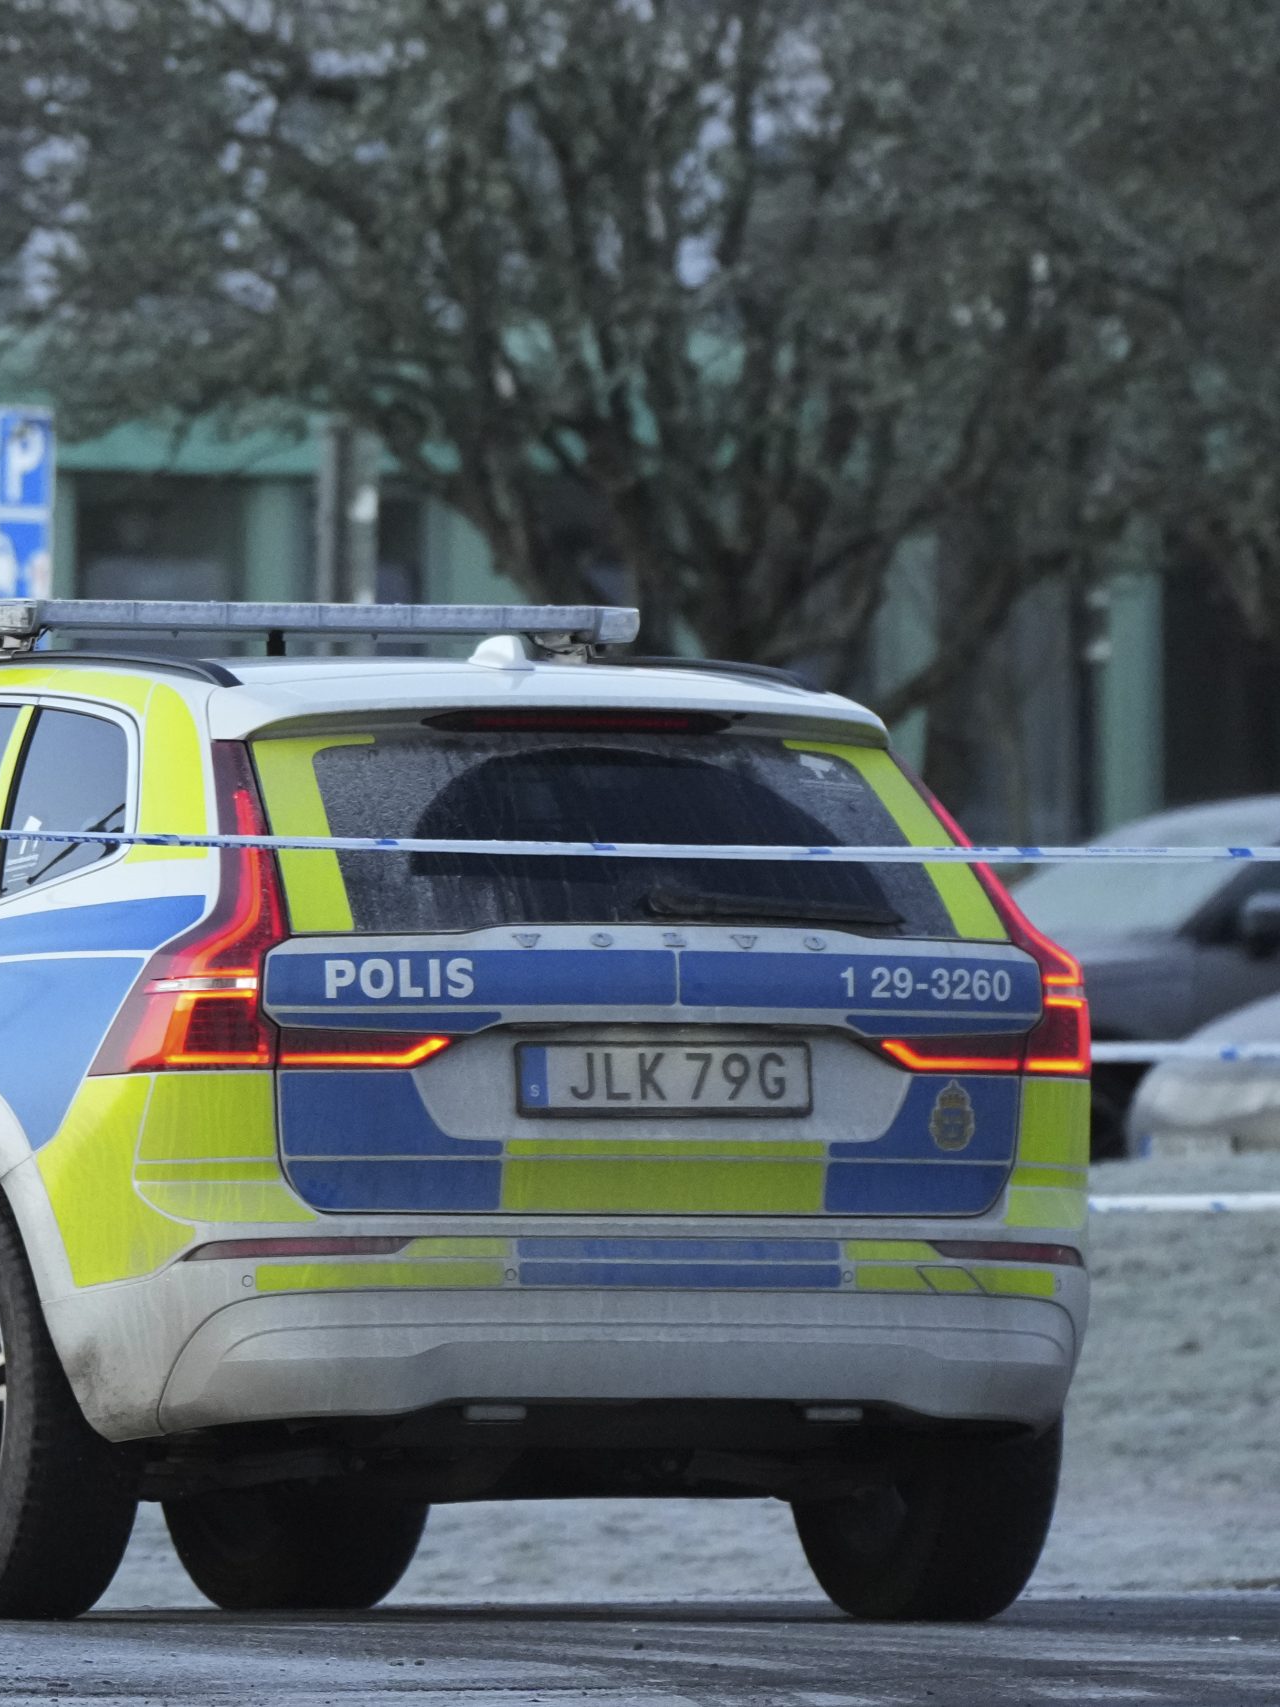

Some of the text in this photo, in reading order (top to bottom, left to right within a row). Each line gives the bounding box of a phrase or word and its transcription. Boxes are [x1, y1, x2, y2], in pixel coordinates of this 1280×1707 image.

[5, 422, 46, 500] P
[511, 931, 827, 952] VOLVO
[324, 957, 475, 999] POLIS
[840, 966, 1012, 1001] 1 29-3260
[570, 1051, 668, 1101] JLK
[685, 1051, 787, 1101] 79G
